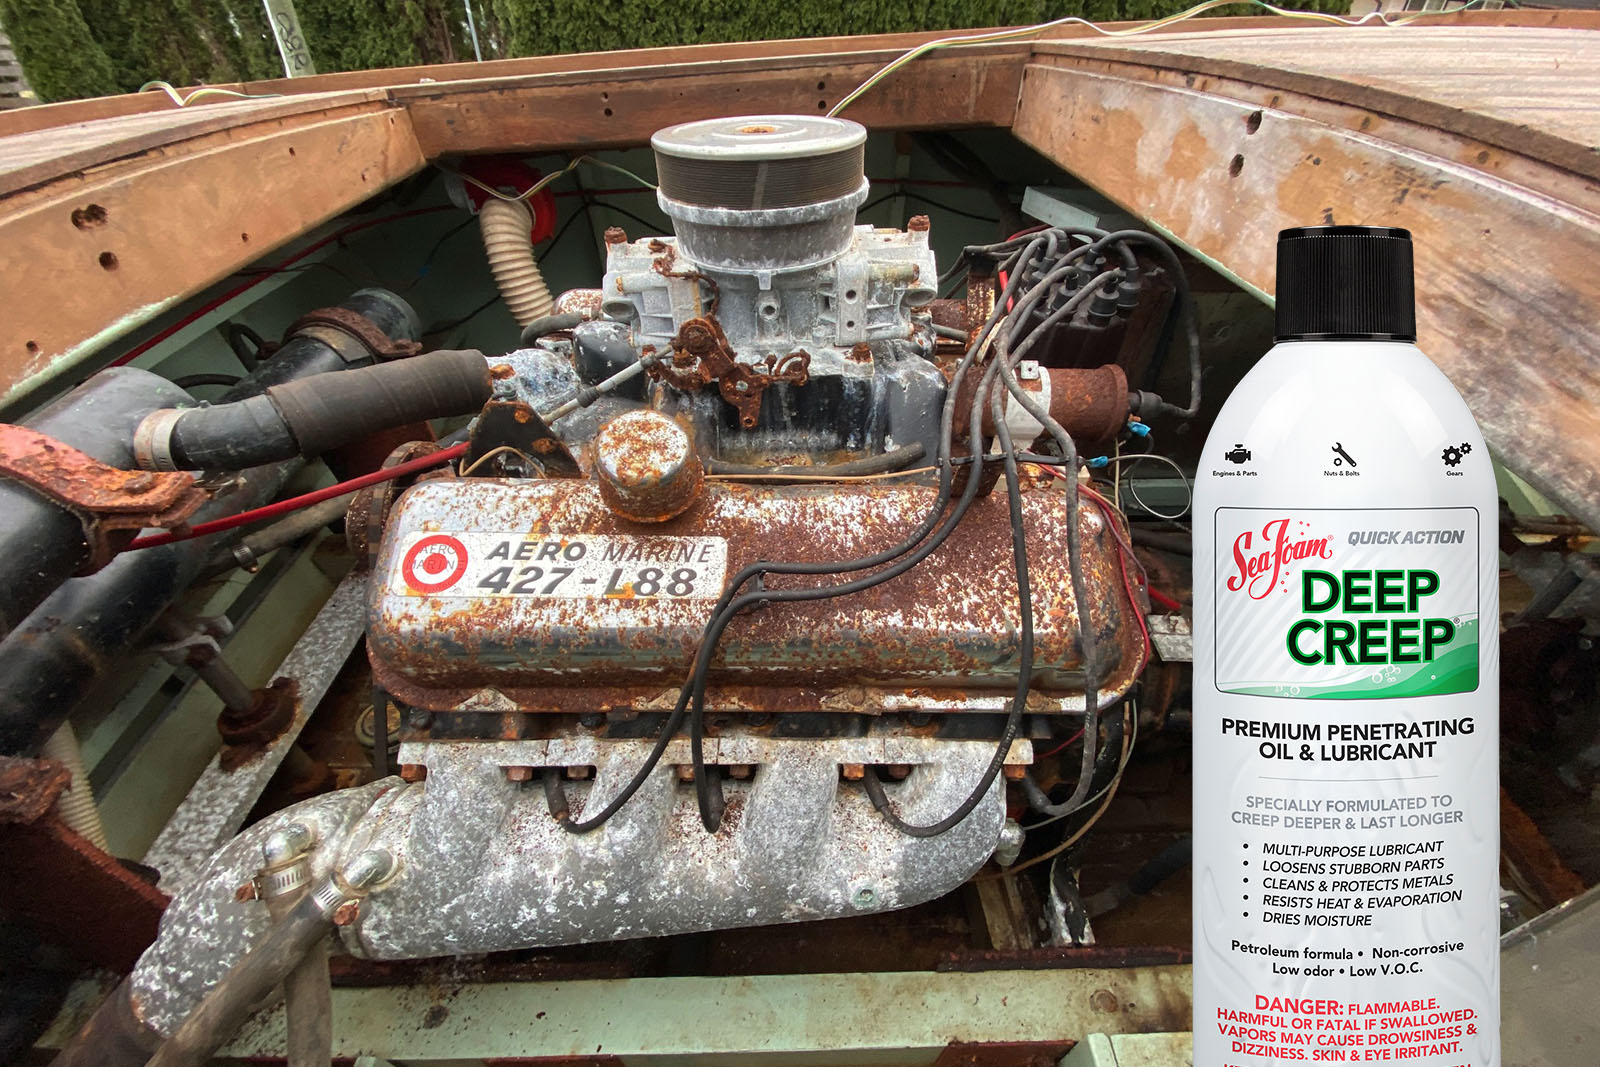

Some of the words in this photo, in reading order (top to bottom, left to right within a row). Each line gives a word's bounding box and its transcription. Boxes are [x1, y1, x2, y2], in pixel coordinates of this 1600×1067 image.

[1348, 531, 1401, 546] QUICK
[1401, 530, 1465, 544] ACTION
[483, 541, 587, 561] AERO
[601, 540, 715, 562] MARINE
[1302, 569, 1440, 613] DEEP
[1286, 618, 1455, 665] CREEP
[1223, 718, 1320, 740] PREMIUM
[1328, 718, 1474, 741] PENETRATING
[1259, 742, 1293, 760] OIL
[1299, 744, 1314, 761] &
[1321, 741, 1437, 761] LUBRICANT
[1247, 796, 1322, 812] SPECIALLY
[1326, 797, 1427, 812] FORMULATED
[1431, 795, 1452, 807] TO
[1232, 811, 1279, 827] CREEP
[1284, 816, 1341, 829] DEEPER
[1345, 818, 1356, 829] &
[1361, 816, 1396, 829] LAST
[1400, 811, 1463, 827] LONGER
[1263, 843, 1366, 857] MULTI-PURPOSE
[1370, 841, 1444, 856] LUBRICANT
[1263, 860, 1325, 874] LOOSENS
[1329, 862, 1401, 874] STUBBORN
[1405, 858, 1444, 871] PARTS
[1263, 878, 1314, 891] CLEANS
[1318, 881, 1328, 892] &
[1332, 879, 1398, 892] PROTECTS
[1403, 874, 1453, 889] METALS
[1263, 895, 1313, 908] RESISTS
[1317, 898, 1351, 909] HEAT
[1354, 898, 1363, 909] &
[1368, 890, 1462, 908] EVAPORATION
[1263, 912, 1300, 925] DRIES
[1305, 915, 1372, 926] MOISTURE
[1232, 940, 1299, 958] Petroleum
[1304, 947, 1353, 959] formula
[1373, 941, 1464, 958] Non-corrosive
[1273, 963, 1299, 975] Low
[1304, 965, 1334, 976] odor
[1350, 966, 1376, 976] Low
[1381, 962, 1423, 975] V.O.C.
[1256, 995, 1343, 1015] DANGER:
[1349, 998, 1440, 1015] FLAMMABLE.
[1218, 1008, 1288, 1028] HARMFUL
[1292, 1018, 1312, 1029] OR
[1317, 1019, 1360, 1030] FATAL
[1365, 1019, 1376, 1030] IF
[1381, 1009, 1477, 1030] SWALLOWED.
[1218, 1023, 1276, 1042] VAPORS
[1281, 1032, 1313, 1045] MAY
[1317, 1035, 1364, 1046] CAUSE
[1369, 1026, 1462, 1046] DROWSINESS
[1467, 1023, 1477, 1035] &
[1232, 1041, 1308, 1060] DIZZINESS.
[1313, 1050, 1345, 1061] SKIN
[1350, 1050, 1360, 1061] &
[1365, 1049, 1391, 1061] EYE
[1396, 1041, 1462, 1059] IRRITANT.
